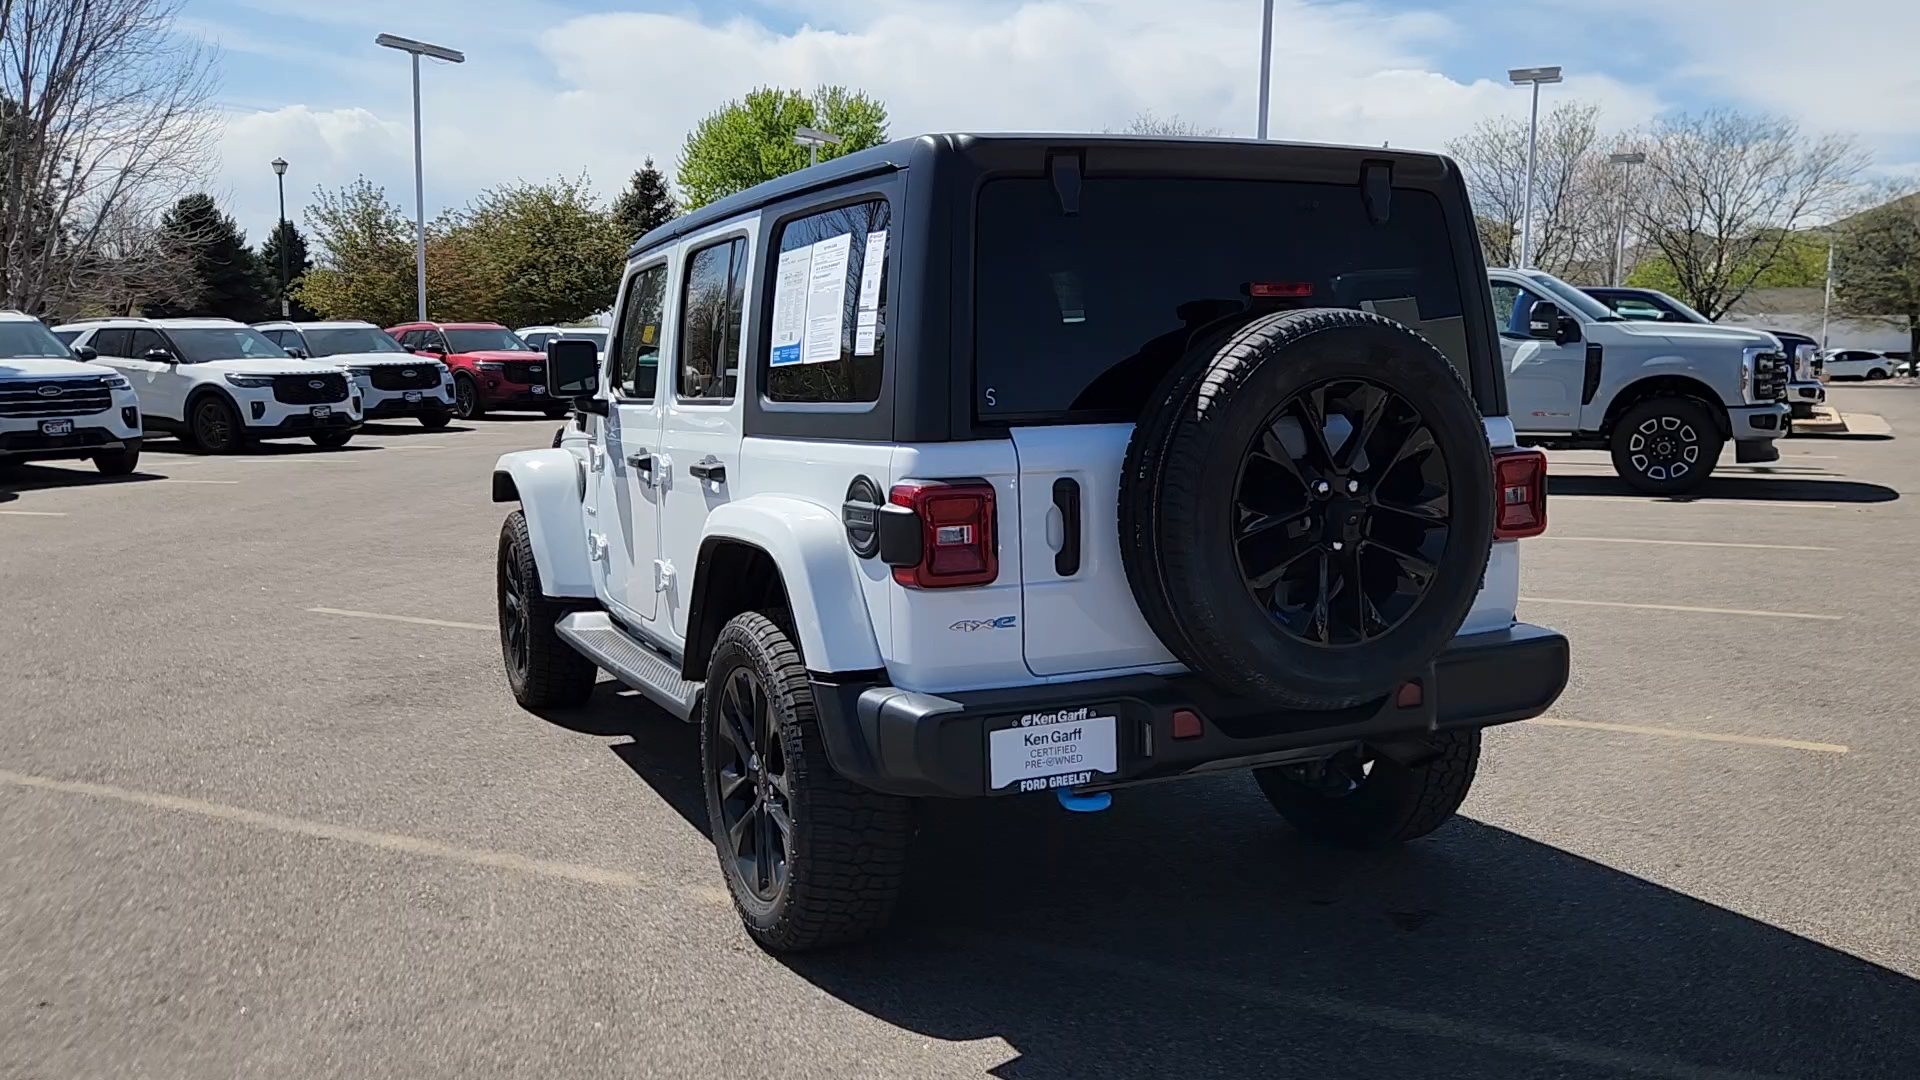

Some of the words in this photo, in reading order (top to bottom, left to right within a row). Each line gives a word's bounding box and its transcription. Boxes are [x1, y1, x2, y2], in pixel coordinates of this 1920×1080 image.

[986, 388, 996, 406] S
[1032, 713, 1057, 726] Ken
[1057, 707, 1088, 722] Garff
[1024, 733, 1049, 746] Ken
[1051, 728, 1082, 742] Garff
[1030, 744, 1077, 758] CERTIFIED
[1020, 778, 1047, 792] FORD
[1049, 771, 1092, 788] GREELEY
